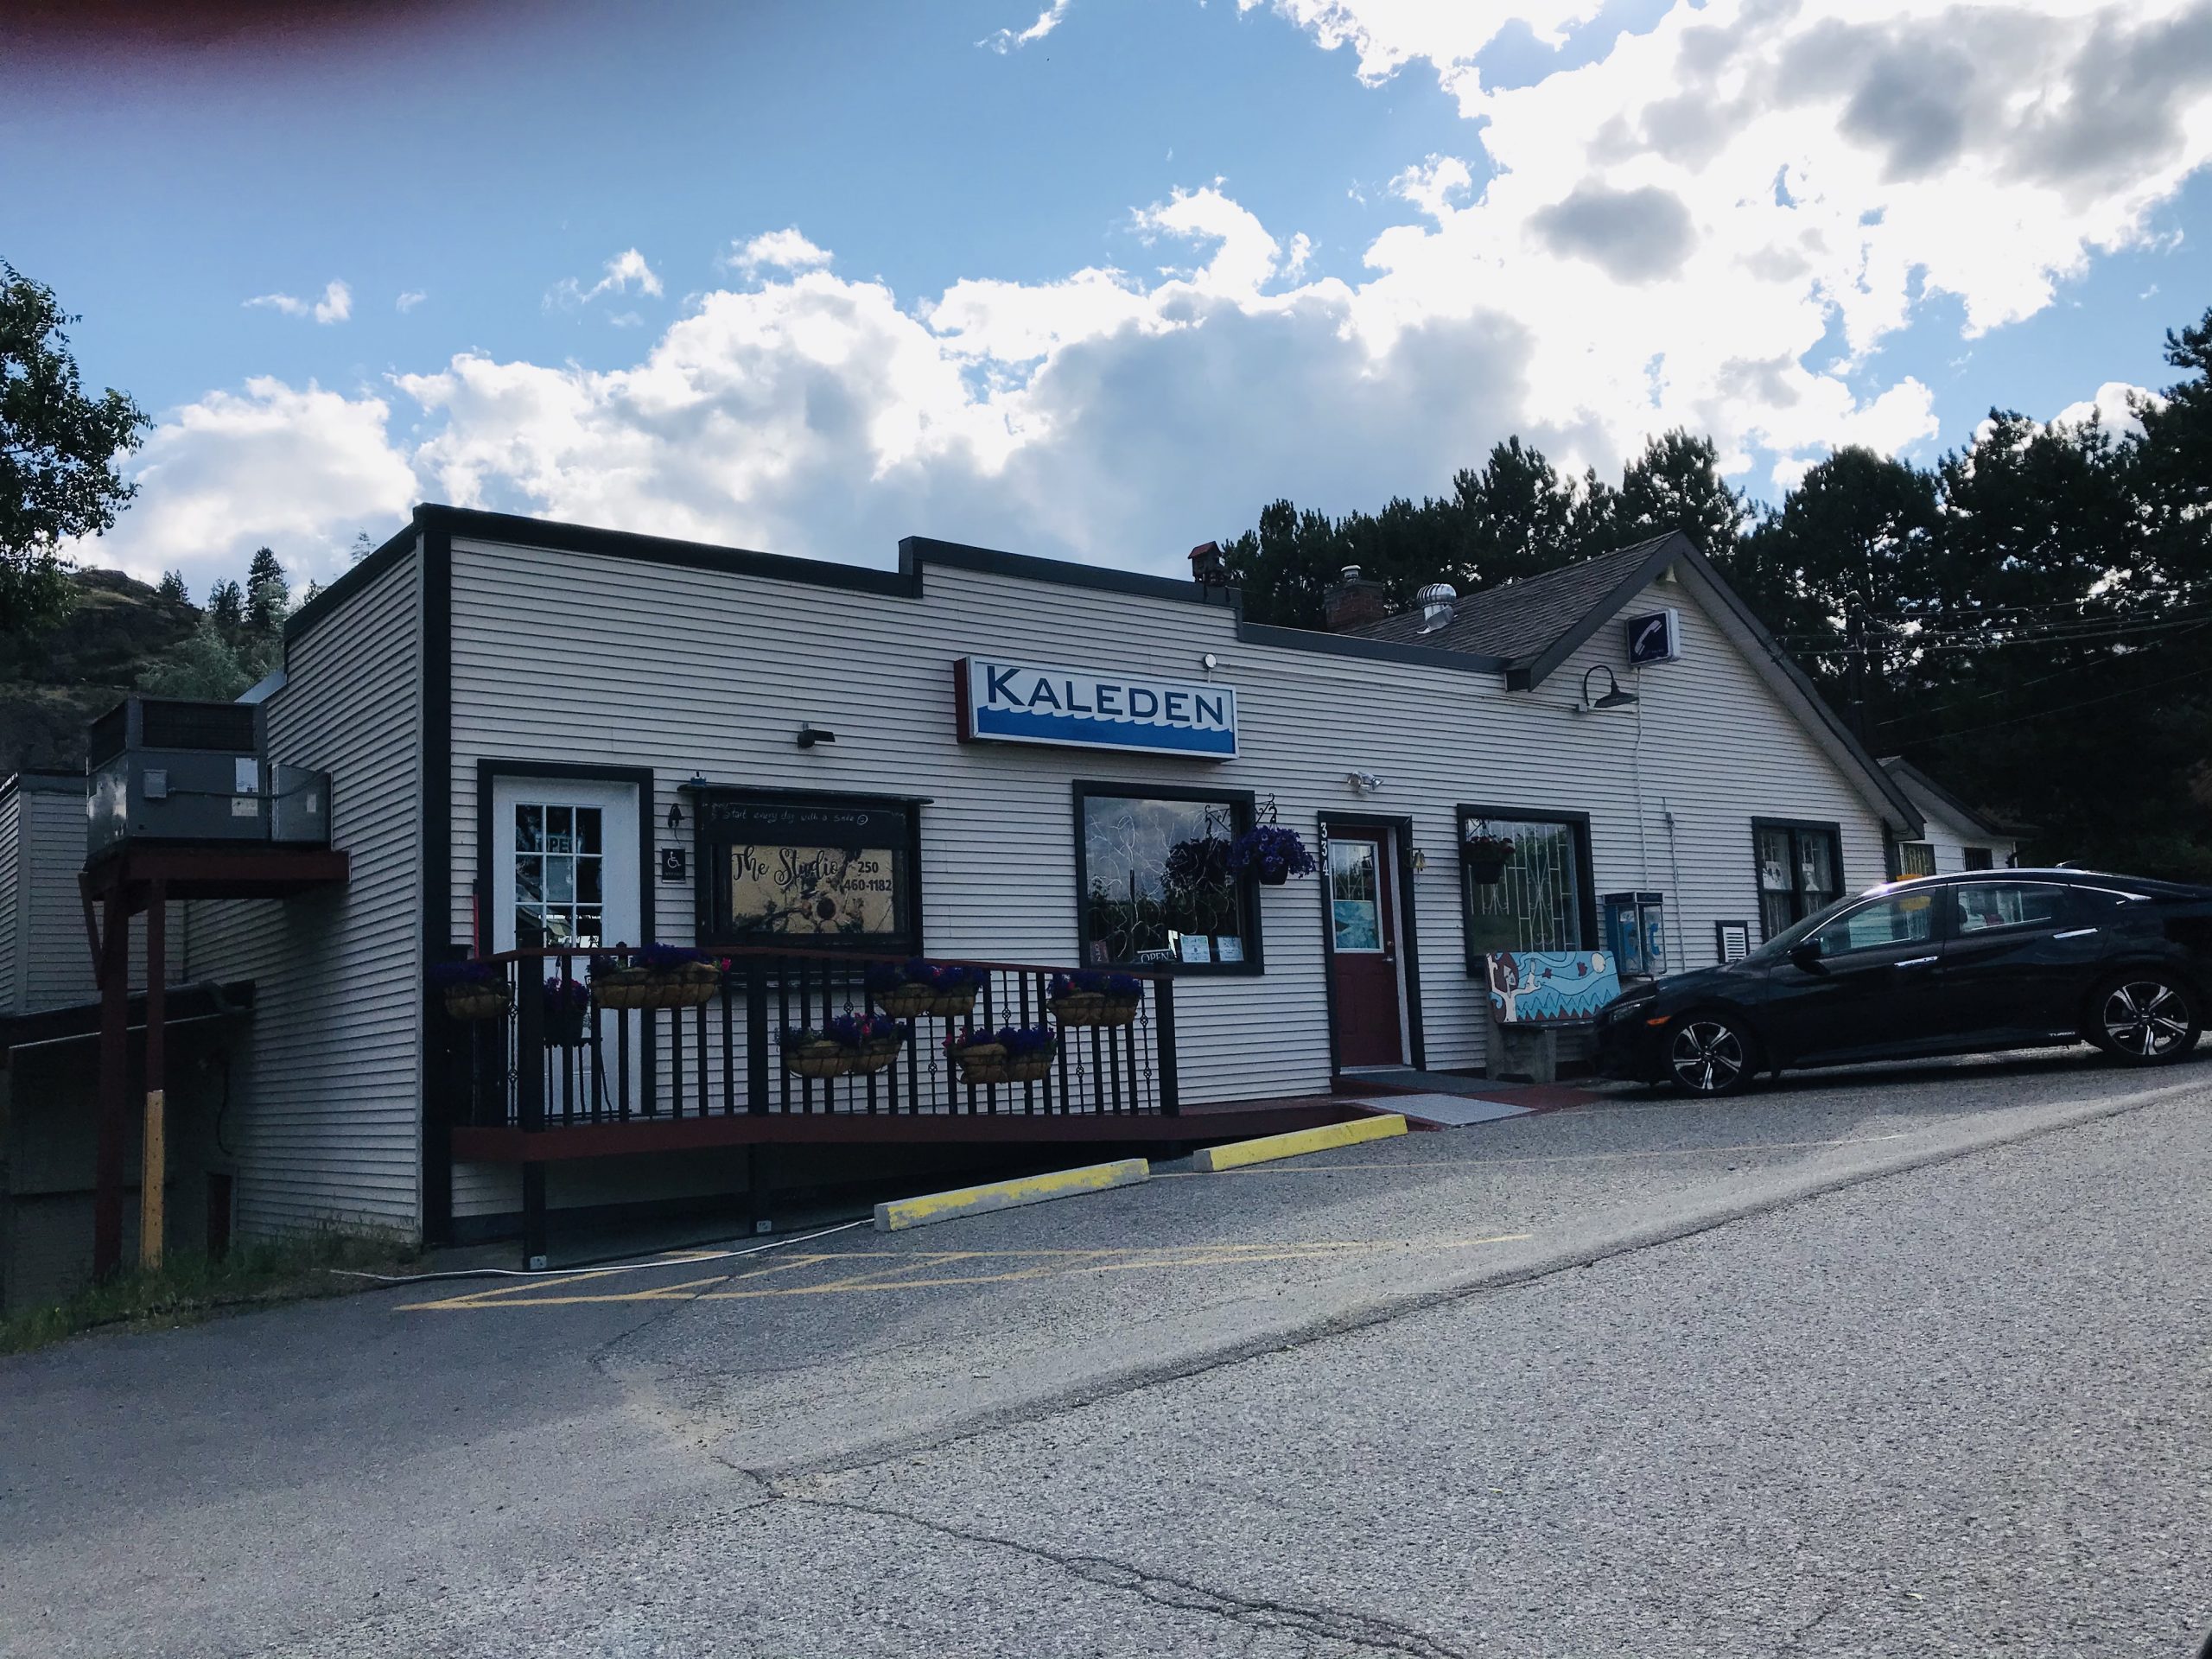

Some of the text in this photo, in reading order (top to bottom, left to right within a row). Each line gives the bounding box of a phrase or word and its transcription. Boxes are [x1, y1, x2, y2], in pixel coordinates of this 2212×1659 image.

[987, 664, 1224, 726] KALEDEN
[800, 812, 817, 822] with
[1320, 822, 1330, 876] 334
[731, 845, 840, 886] The Studio
[857, 861, 879, 874] 250
[843, 879, 893, 892] 460-1182
[1141, 952, 1169, 963] OPEN
